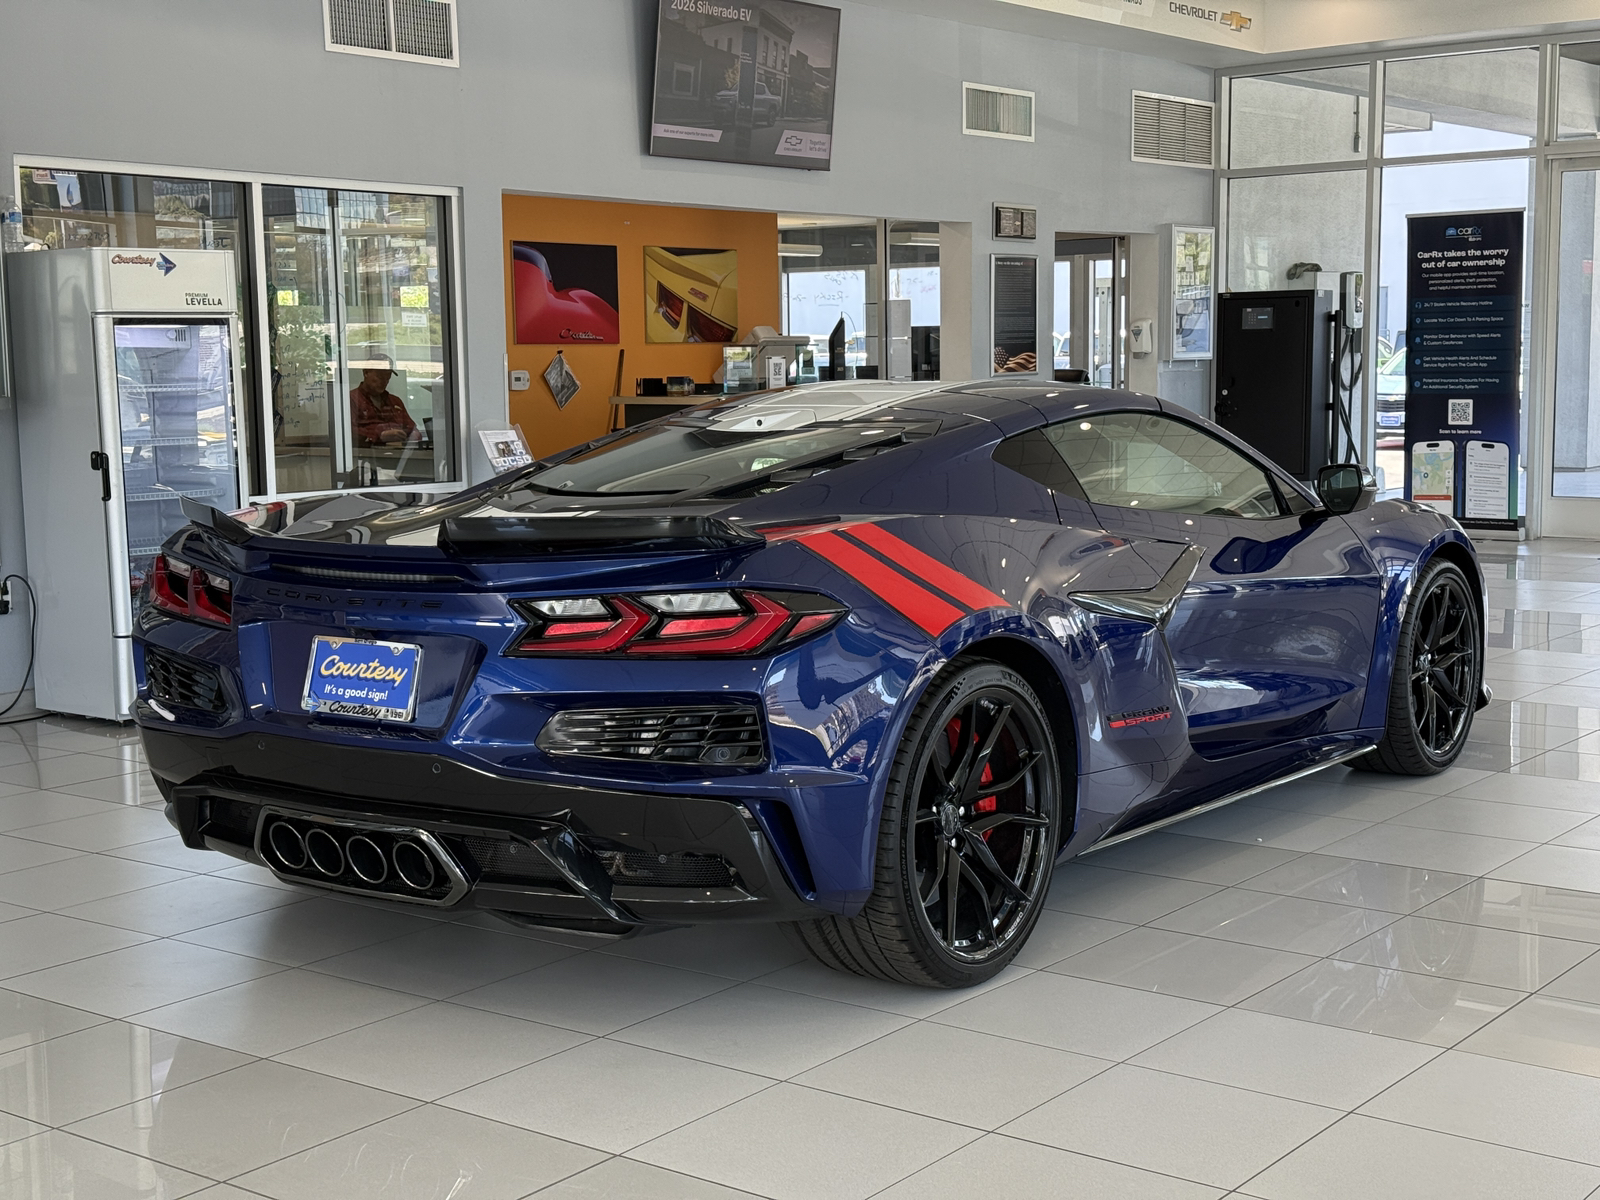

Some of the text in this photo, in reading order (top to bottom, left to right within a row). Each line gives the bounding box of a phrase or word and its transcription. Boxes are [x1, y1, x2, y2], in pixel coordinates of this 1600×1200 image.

[671, 0, 752, 22] 2026 Silverado EV
[1169, 2, 1218, 22] CHEVROLET
[1482, 248, 1509, 256] worry
[1437, 260, 1445, 268] of
[1462, 258, 1506, 267] ownership
[186, 298, 222, 306] LEVELLA
[266, 588, 445, 609] CORVETTE
[320, 655, 408, 688] Courtesy
[324, 684, 335, 694] It's
[345, 688, 368, 698] good
[368, 690, 388, 702] sign!
[329, 701, 381, 718] Courtesy
[1122, 705, 1169, 718] GRAND
[1125, 712, 1172, 726] SPORT
[1004, 911, 1024, 938] FORGED
